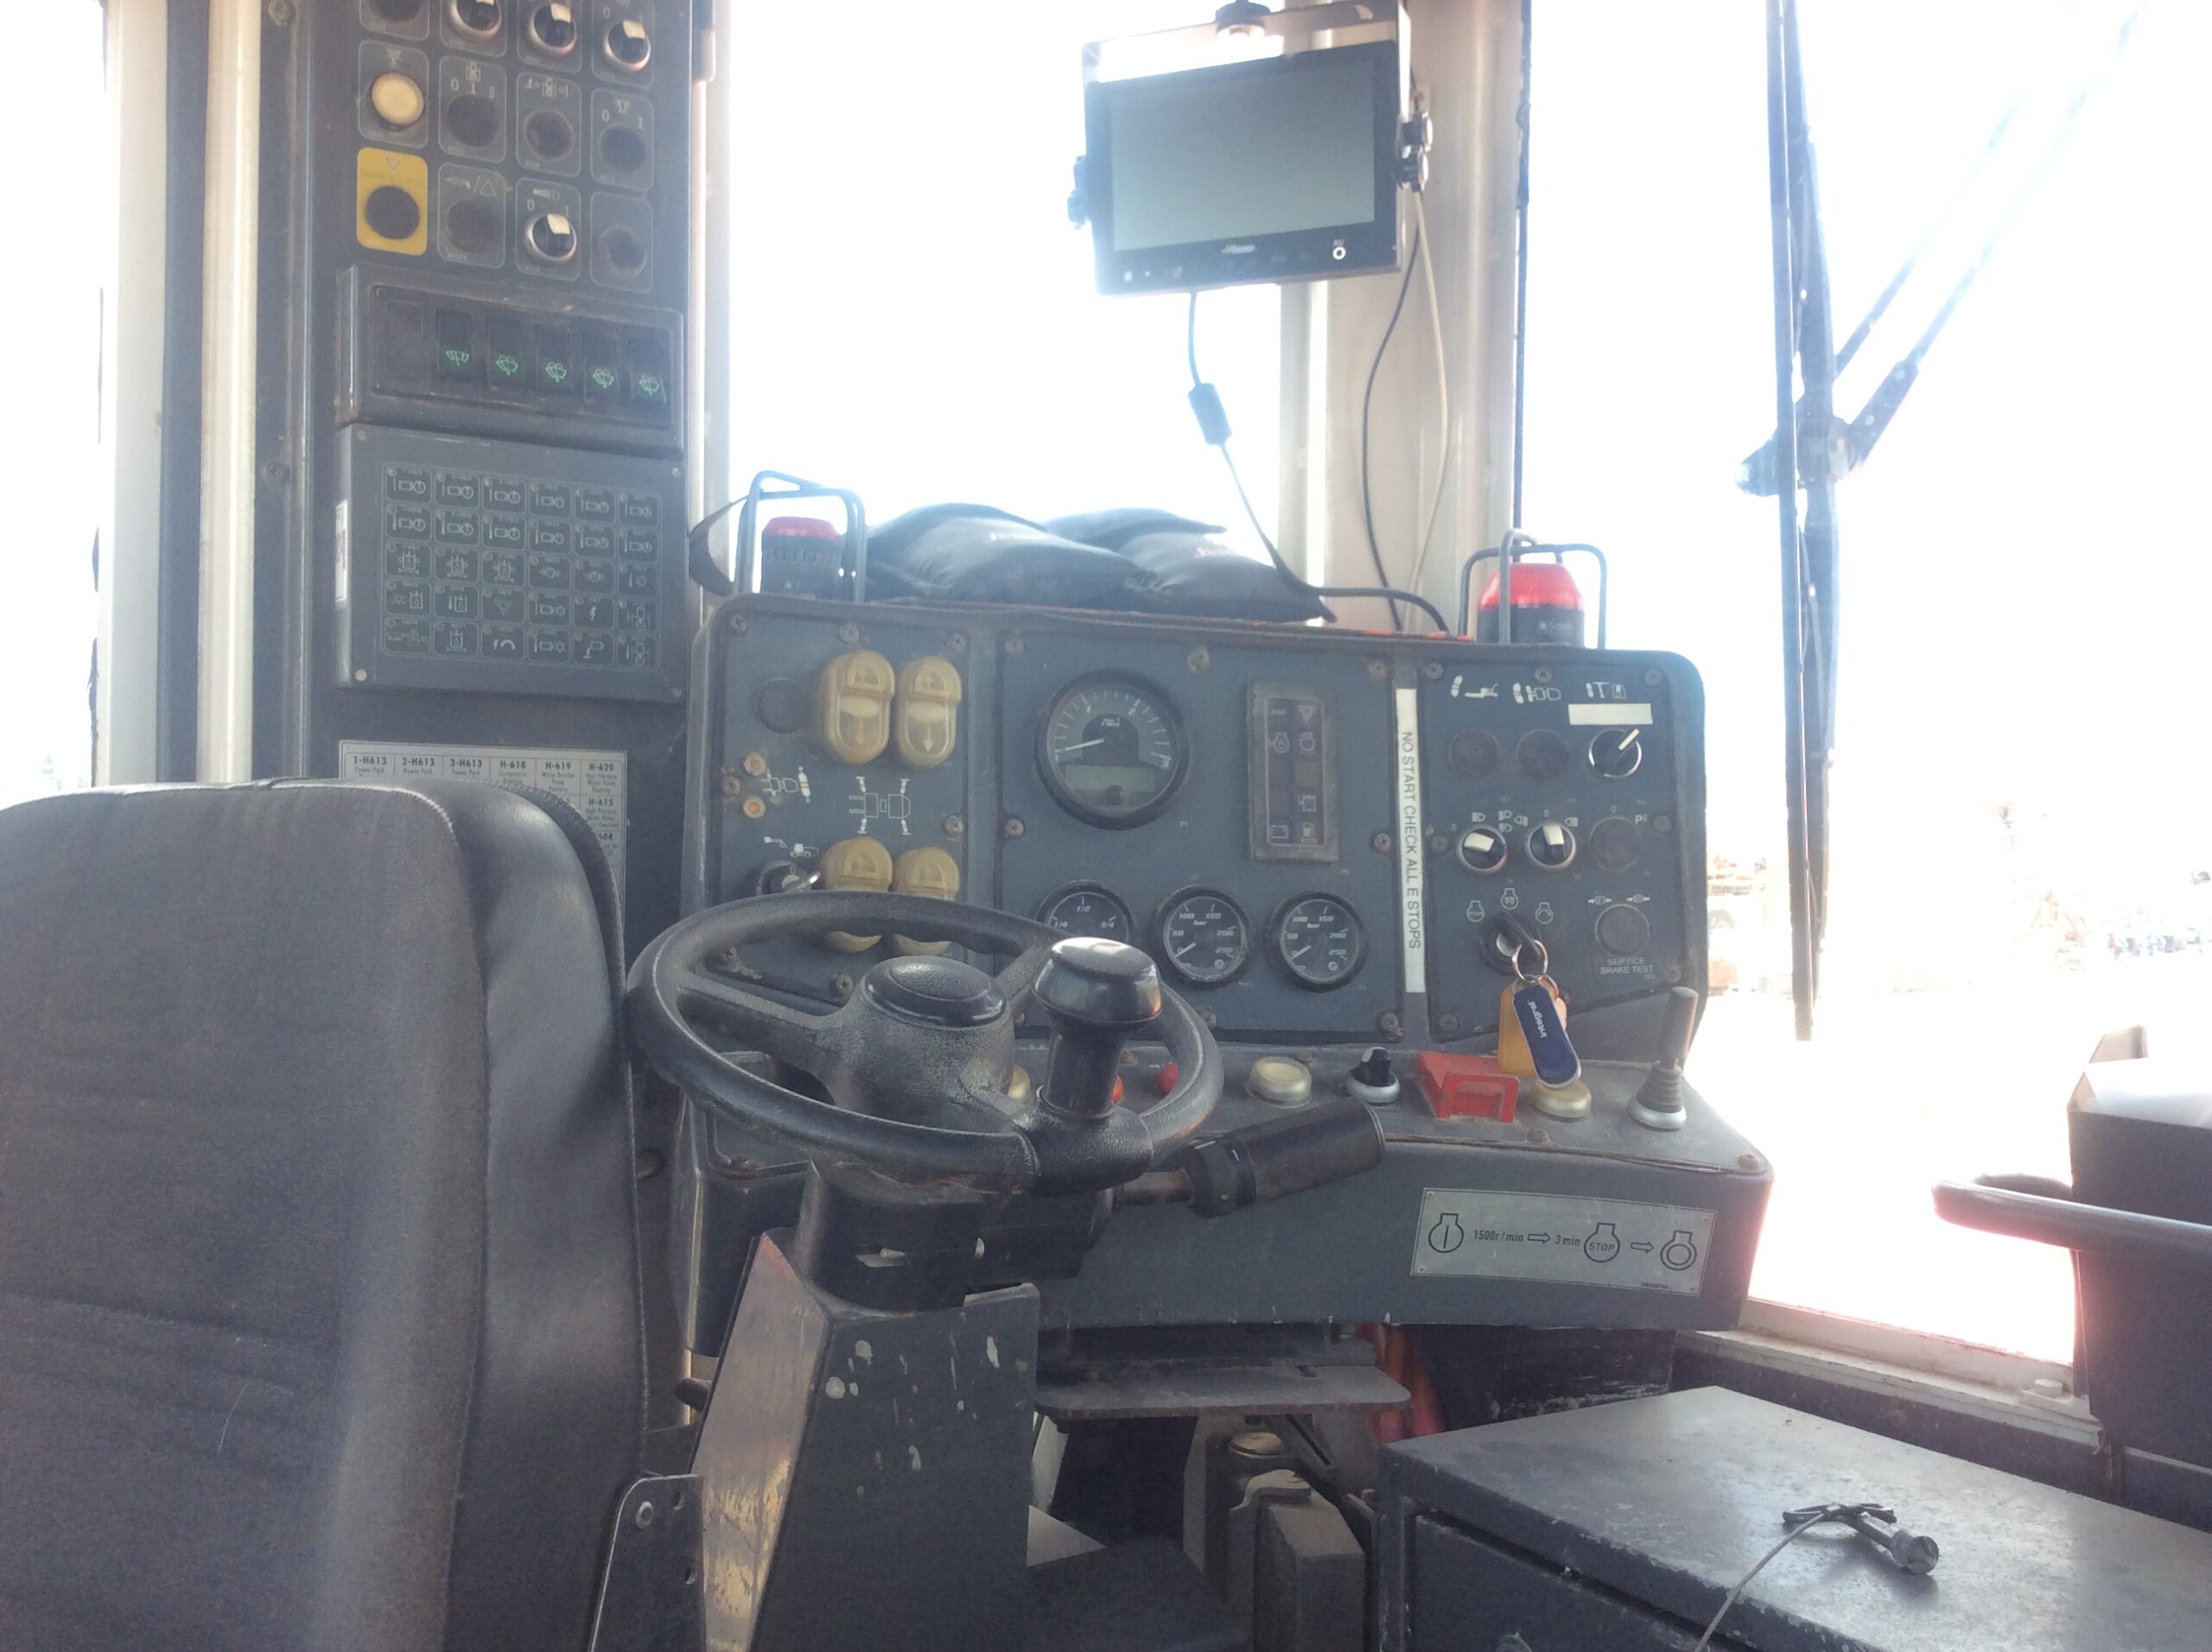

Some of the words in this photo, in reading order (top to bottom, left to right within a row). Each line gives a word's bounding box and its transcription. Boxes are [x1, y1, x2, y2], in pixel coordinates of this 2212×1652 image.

[1402, 732, 1414, 753] NO
[353, 756, 387, 766] 1-H613
[402, 757, 435, 766] 2-H613
[450, 759, 482, 768] 3-H613
[545, 761, 572, 770] H-619
[588, 763, 614, 772] H-620
[1402, 756, 1415, 802] START
[588, 797, 614, 807] H-615
[1404, 805, 1417, 854] CHECK
[1406, 858, 1419, 883] ALL
[1407, 887, 1419, 897] E
[1408, 900, 1421, 950] STOPS
[1607, 956, 1645, 966] SERVICE
[1600, 966, 1630, 975] BRAKE
[1630, 964, 1653, 974] TEST
[1555, 1234, 1561, 1245] 3
[1562, 1236, 1581, 1247] min
[1588, 1242, 1616, 1252] STOP
